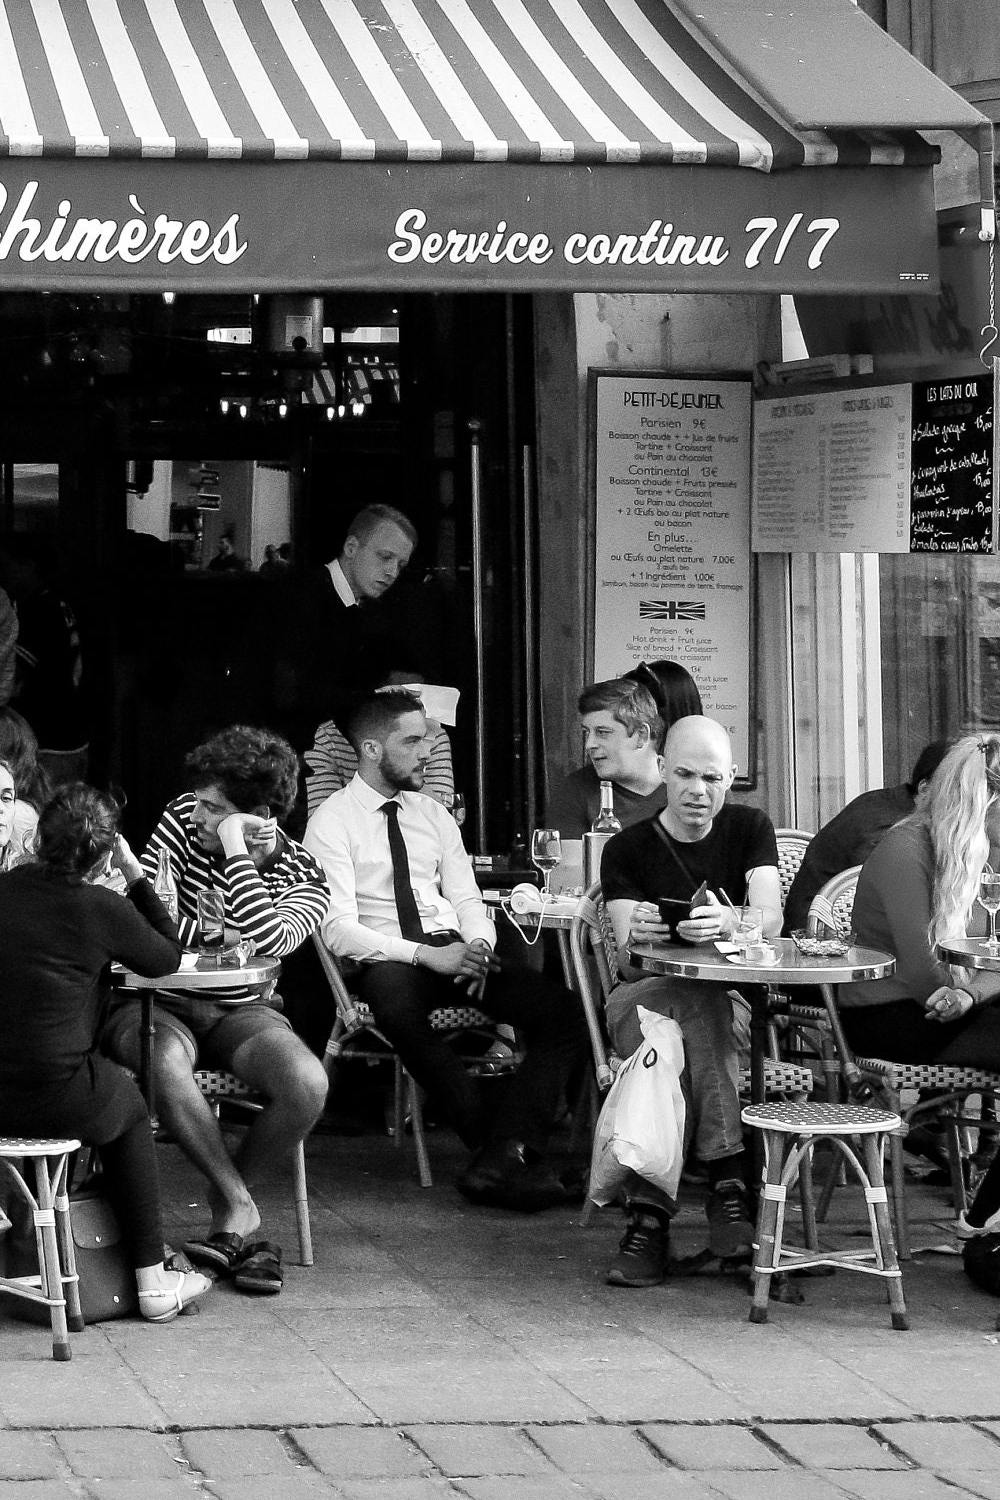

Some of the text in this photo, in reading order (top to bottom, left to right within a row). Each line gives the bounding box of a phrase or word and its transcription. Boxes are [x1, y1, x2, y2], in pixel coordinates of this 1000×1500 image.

[388, 208, 839, 269] Service continu 7/7
[641, 417, 706, 429] Parisien 9€
[609, 431, 638, 439] Boisson
[642, 432, 671, 440] chaude
[629, 465, 689, 476] Continental
[610, 477, 639, 485] Boisson
[642, 478, 672, 486] chaude
[648, 532, 660, 541] En
[654, 544, 692, 552] Omelette
